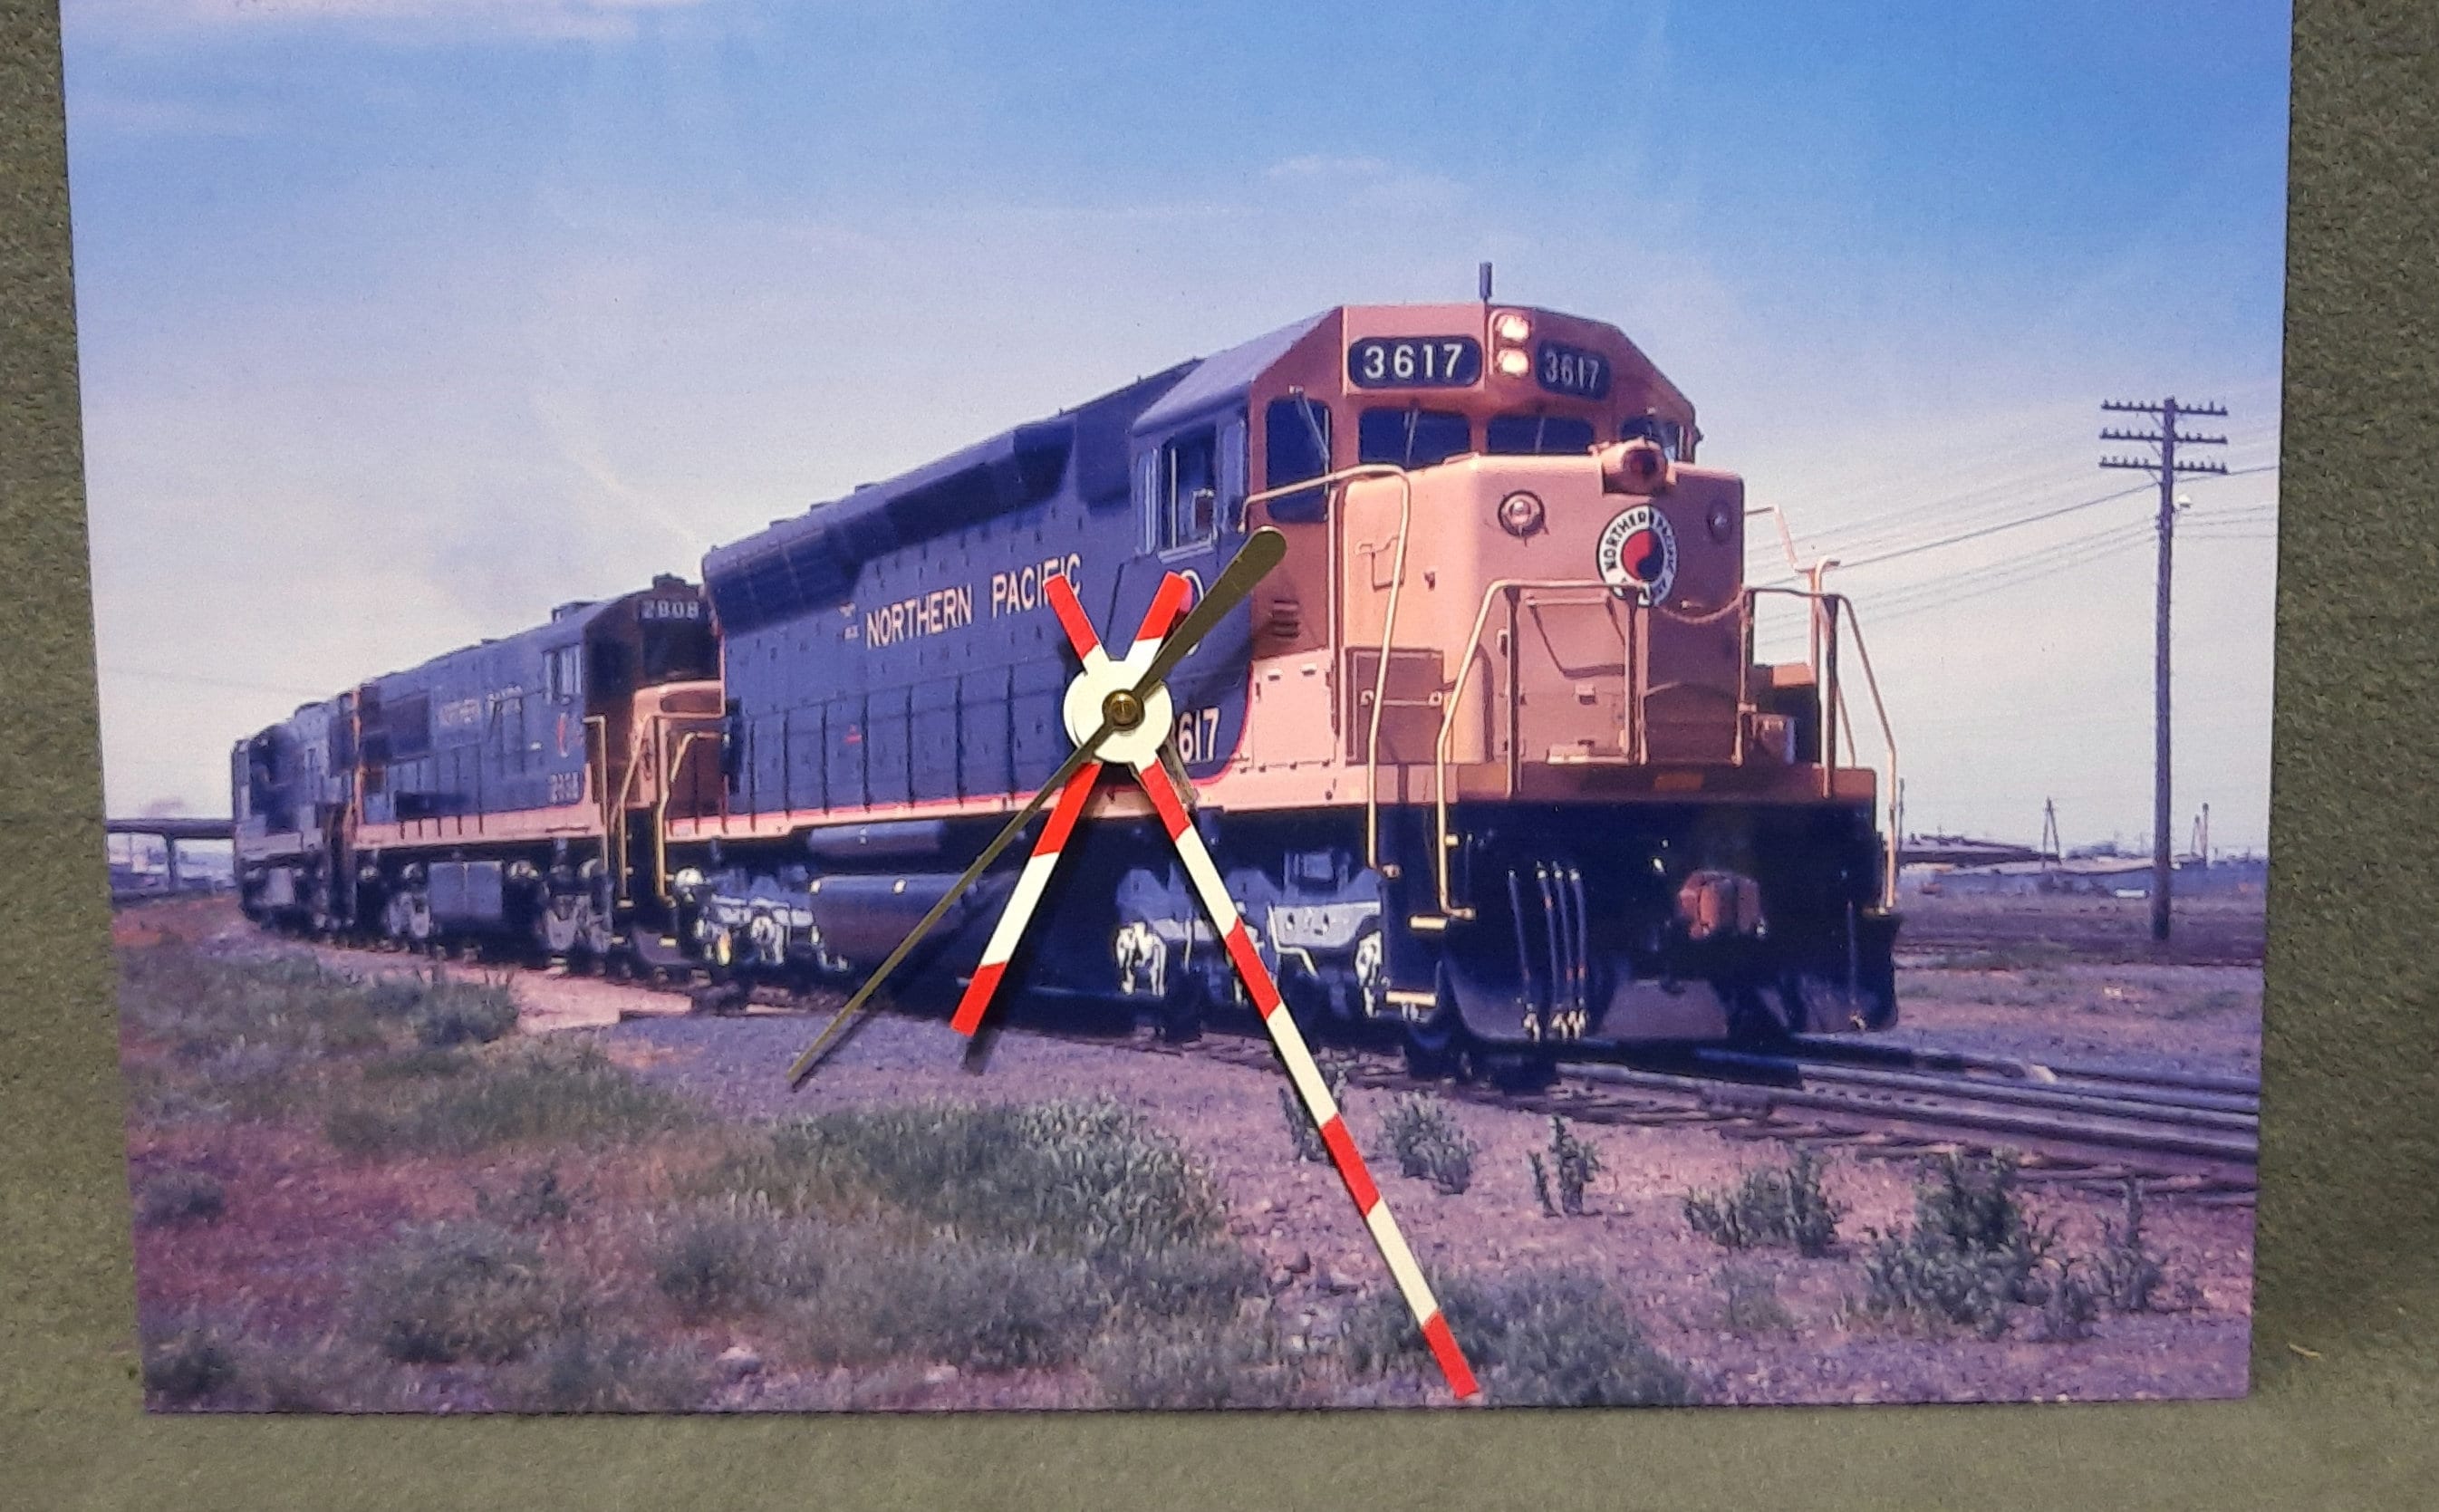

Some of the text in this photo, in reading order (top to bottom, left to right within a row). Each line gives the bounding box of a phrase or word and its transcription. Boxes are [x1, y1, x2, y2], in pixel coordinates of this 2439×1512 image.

[1364, 343, 1463, 379] 3617
[1544, 348, 1600, 390] 3617
[865, 583, 973, 650] NORTHERN
[1174, 707, 1220, 766] 617
